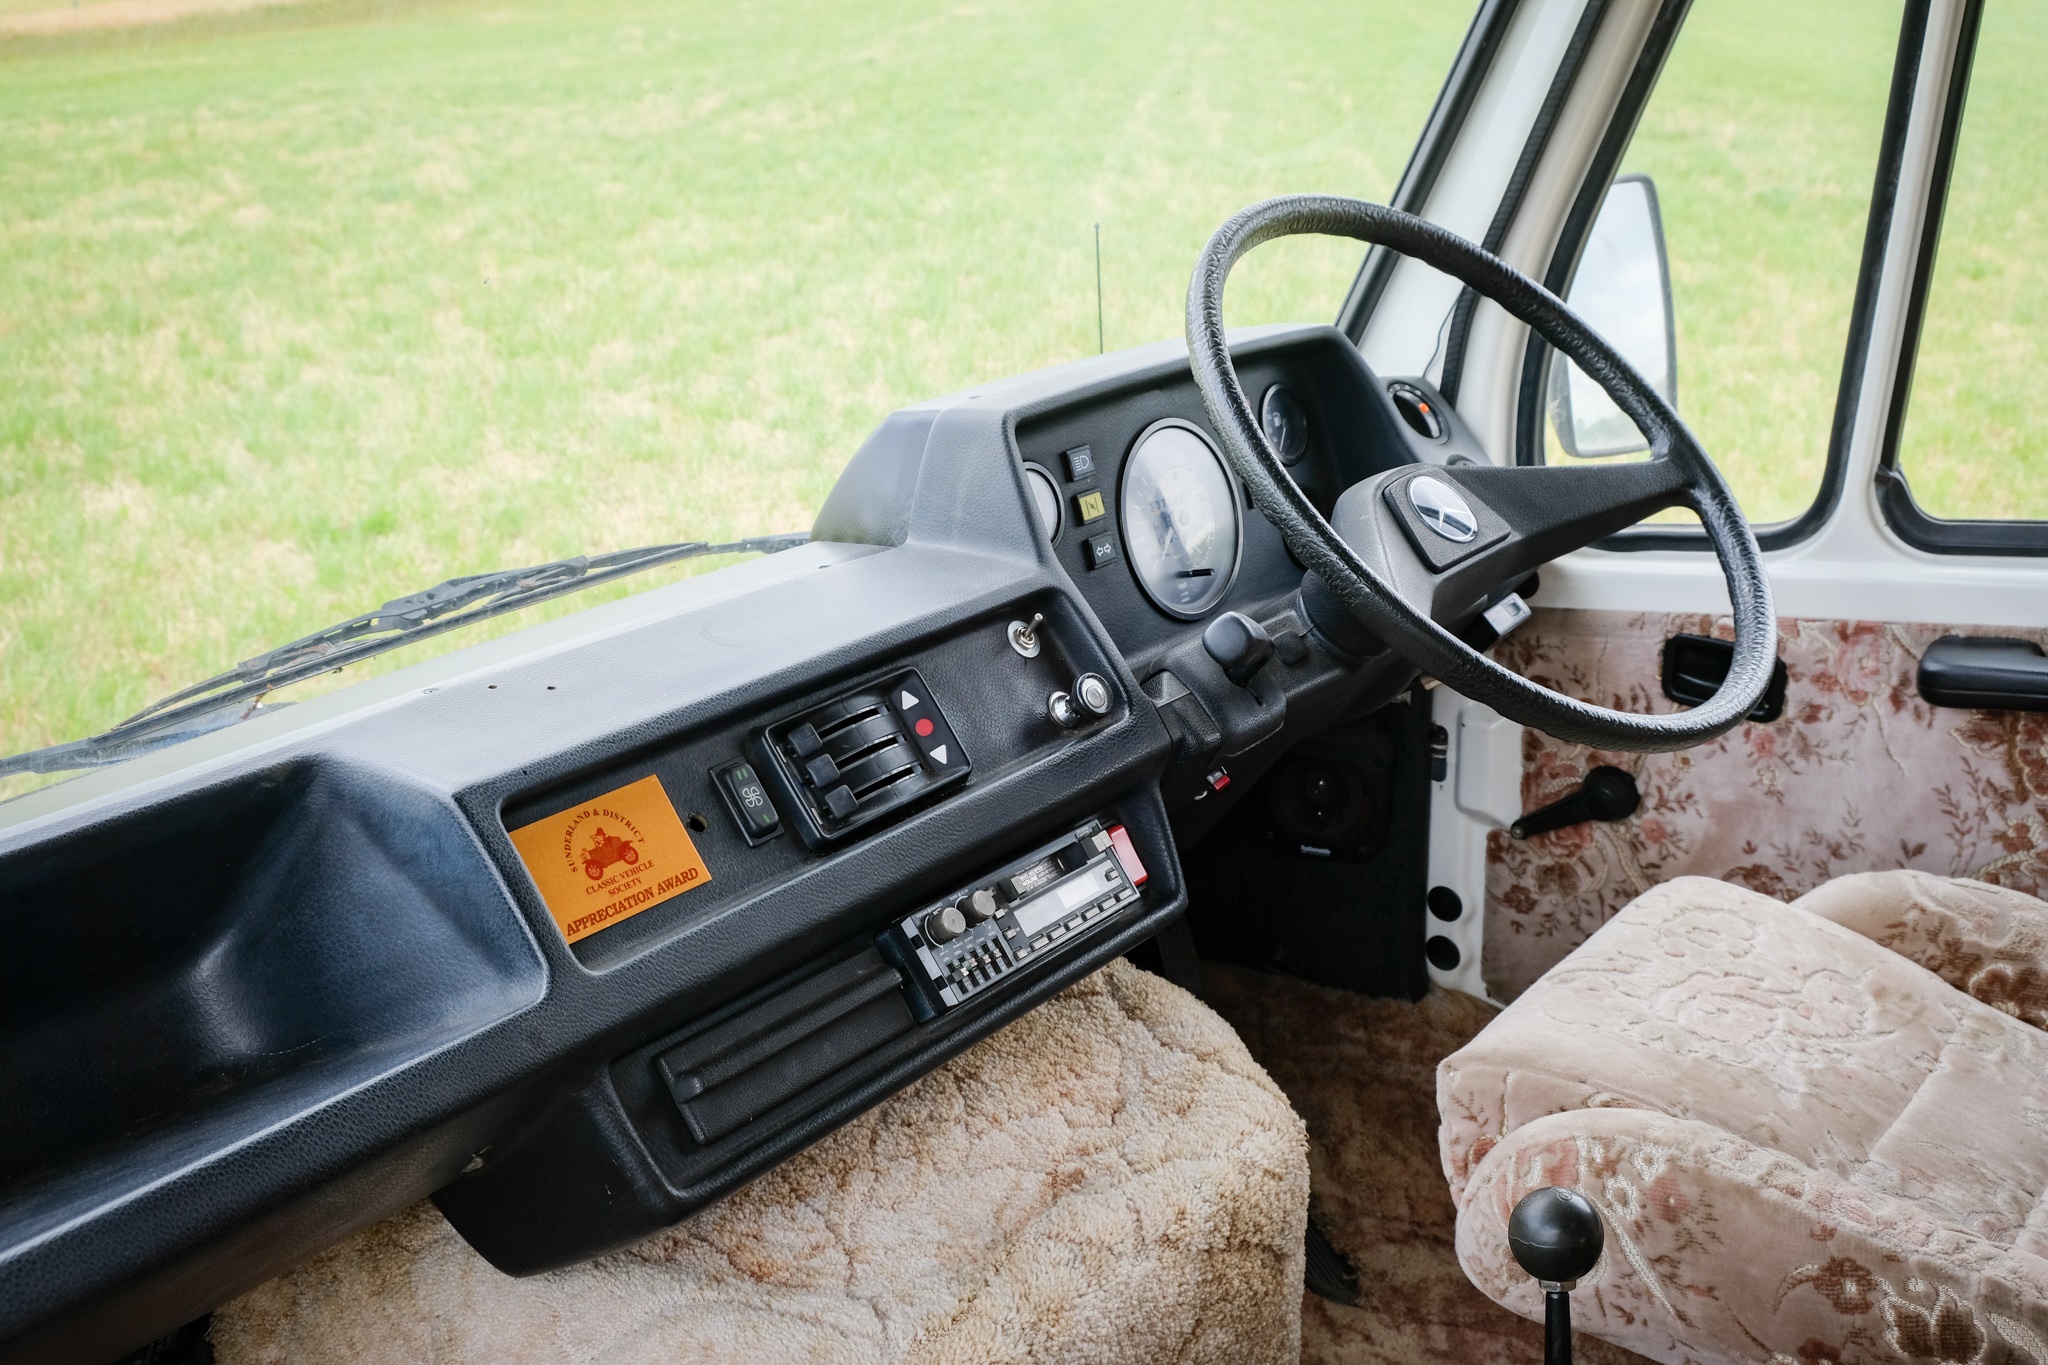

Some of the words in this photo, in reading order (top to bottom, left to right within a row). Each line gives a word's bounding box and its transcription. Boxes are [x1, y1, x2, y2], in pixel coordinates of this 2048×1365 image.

[564, 810, 591, 873] SUNDERLAND
[592, 808, 600, 817] &
[603, 808, 646, 845] DISTRICT
[566, 886, 654, 937] APPRECIATION
[657, 867, 699, 896] AWARD
[585, 874, 619, 896] CLASSIC
[619, 859, 655, 882] VEHICLE
[608, 876, 643, 898] SOCIETY
